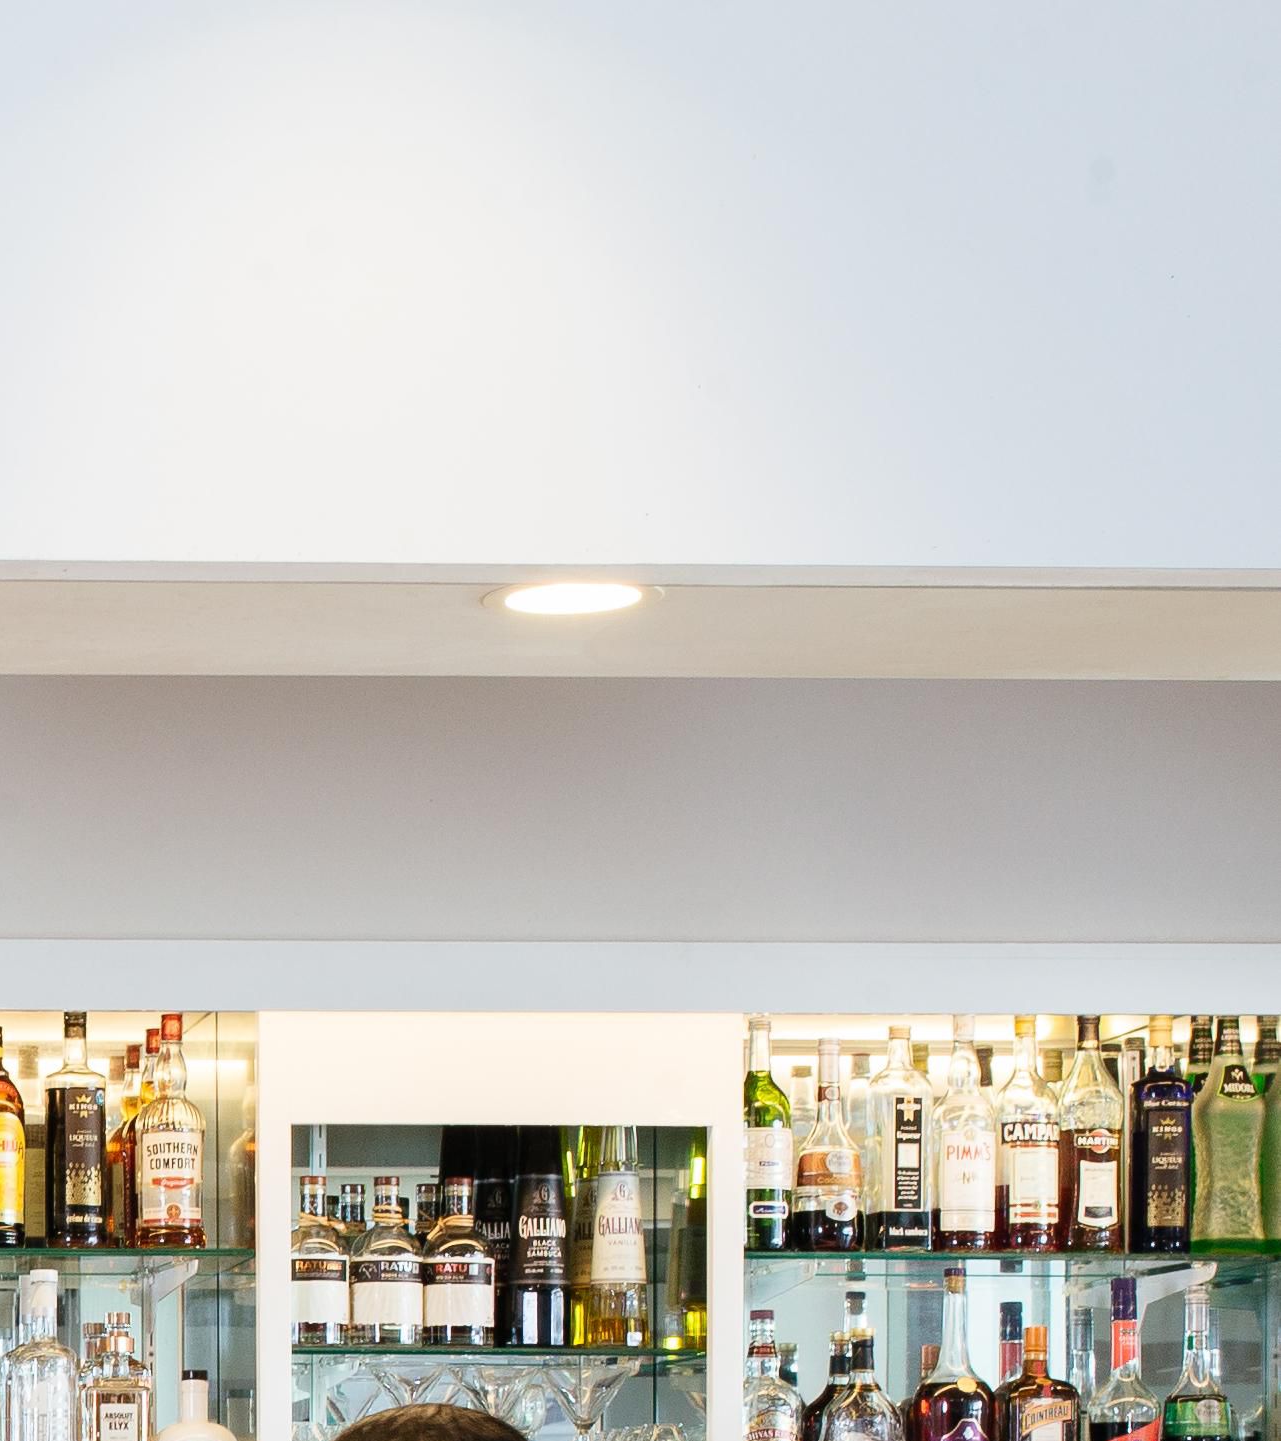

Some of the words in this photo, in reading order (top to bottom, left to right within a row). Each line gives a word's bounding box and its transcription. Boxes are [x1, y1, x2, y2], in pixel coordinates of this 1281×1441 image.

[1223, 1083, 1256, 1093] MIDORI
[147, 1142, 198, 1157] SOUTHERN
[946, 1144, 991, 1162] PIMM'S
[150, 1157, 196, 1171] COMFORT
[475, 1220, 511, 1239] GALLIA
[519, 1215, 566, 1239] GALLIANO
[527, 1250, 562, 1258] SAMBUCA
[295, 1261, 327, 1271] RATU
[380, 1260, 413, 1271] RATU
[435, 1263, 468, 1272] RATU
[105, 1412, 133, 1420] ABSOLUT
[1025, 1405, 1069, 1430] COINTREAU
[108, 1421, 129, 1430] ELYX
